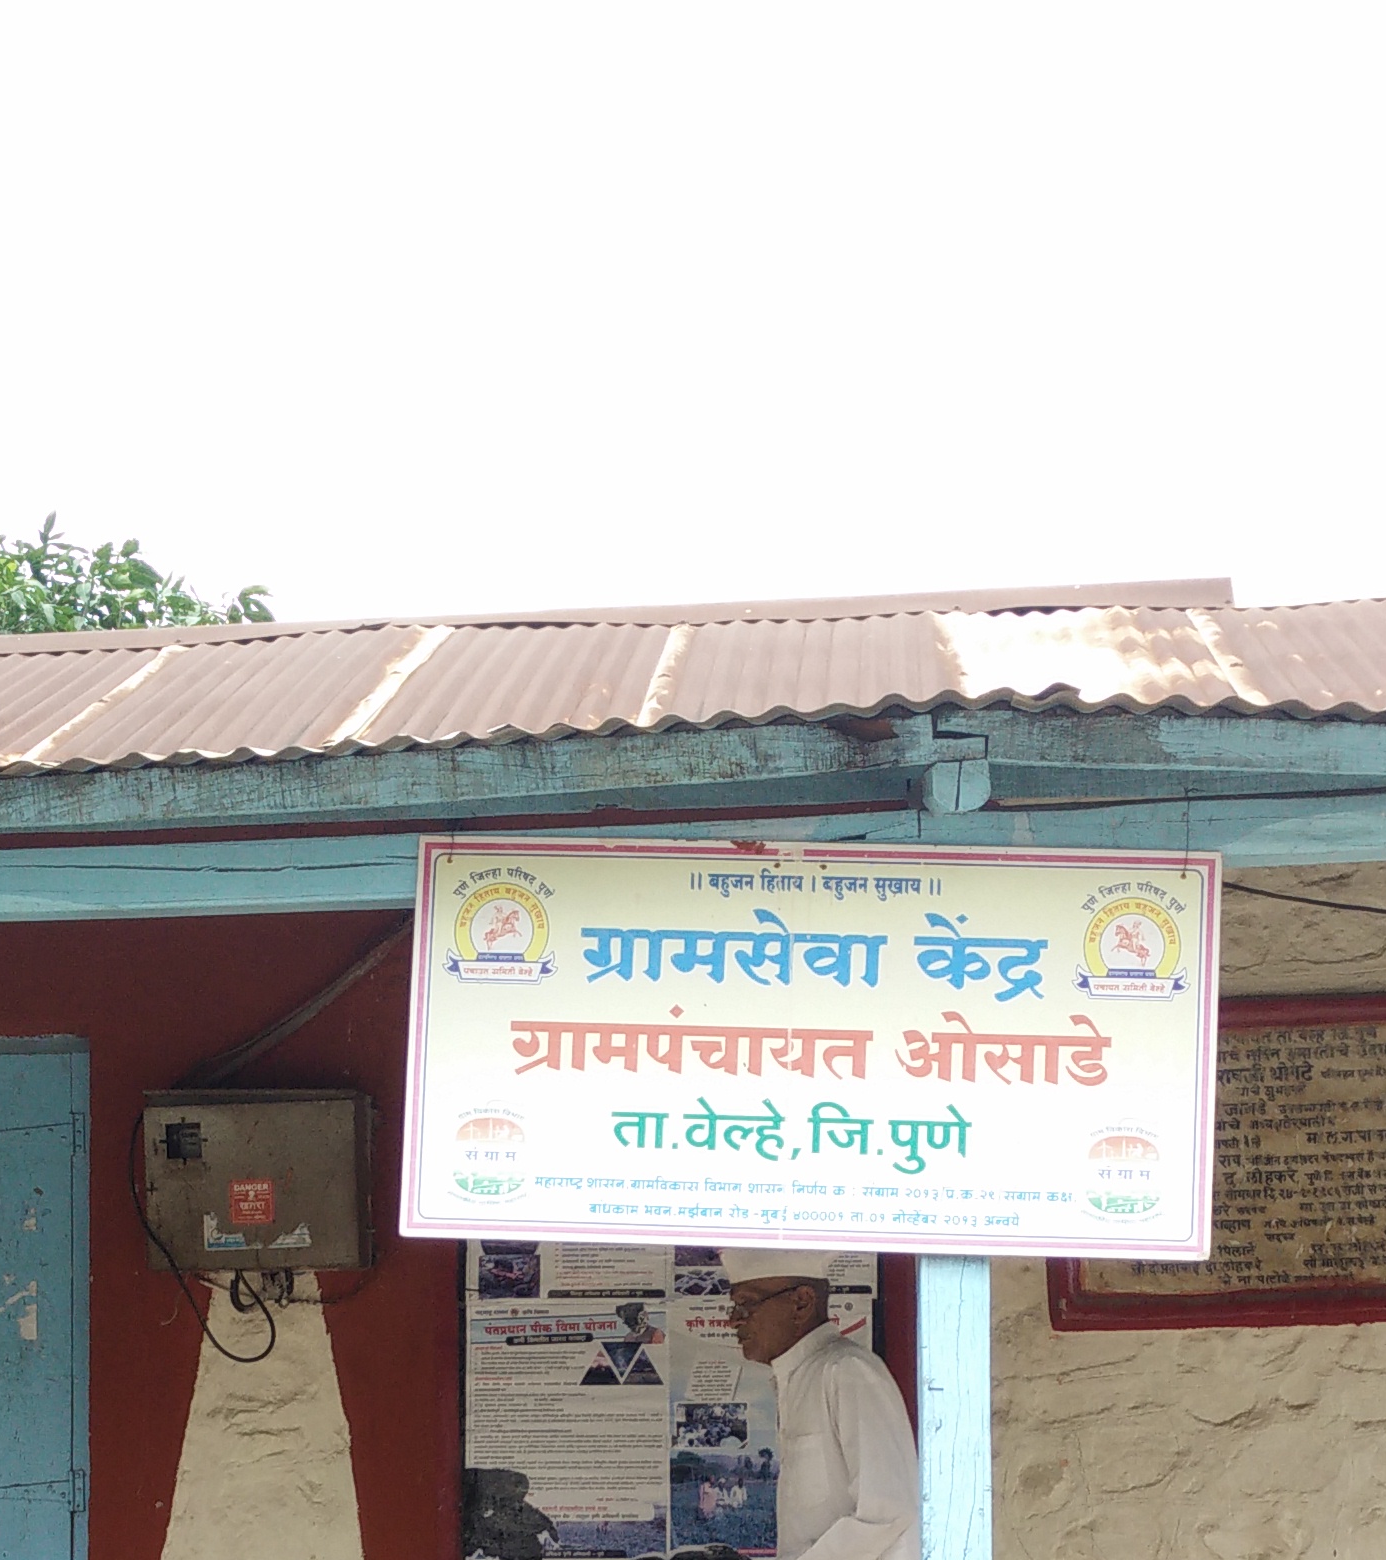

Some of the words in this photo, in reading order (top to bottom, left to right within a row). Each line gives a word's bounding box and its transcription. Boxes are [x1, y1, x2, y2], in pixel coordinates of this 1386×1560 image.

[873, 877, 921, 901] सुखाय
[581, 909, 888, 988] ग्रामसेवा
[913, 912, 1049, 1001] केंद्र
[510, 1005, 874, 1080] ग्रामपंचायत
[895, 1011, 1112, 1087] ओसाडे
[233, 1183, 269, 1192] DANGER
[484, 1322, 526, 1336] पंतप्रधान
[530, 1320, 552, 1334] पीक
[556, 1319, 580, 1333] विमा
[584, 1318, 617, 1331] योजना
